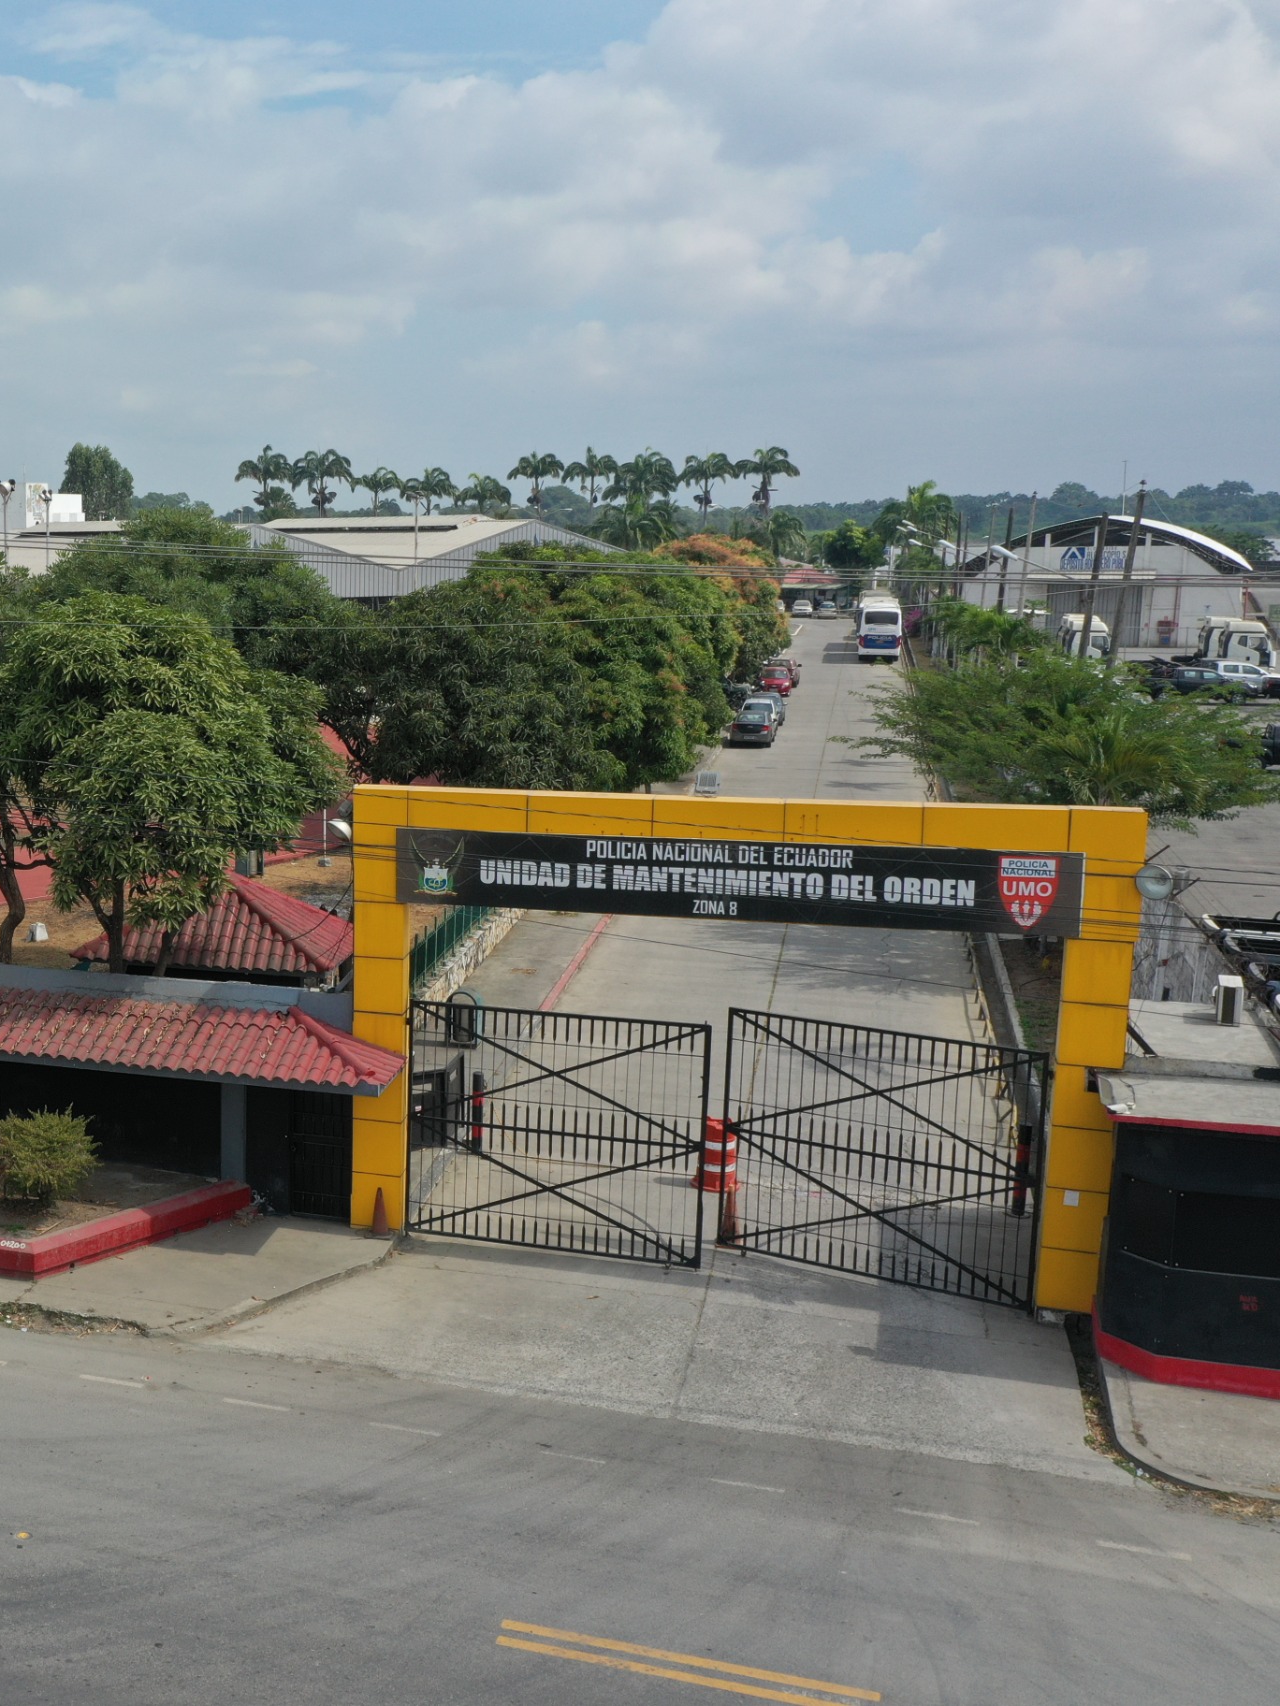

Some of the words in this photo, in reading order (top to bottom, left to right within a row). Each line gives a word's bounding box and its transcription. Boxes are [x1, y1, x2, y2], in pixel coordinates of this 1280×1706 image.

[586, 839, 647, 861] POLICIA
[652, 842, 733, 863] NACIONAL
[738, 845, 768, 865] DEL
[773, 846, 853, 869] ECUADOR
[1002, 867, 1055, 877] NACIONAL
[1008, 860, 1049, 869] POLICIA
[480, 859, 570, 888] UNIDAD
[576, 863, 606, 890] DE
[612, 864, 824, 900] MANTENIMIENTO
[831, 874, 877, 903] DEL
[883, 875, 976, 907] ORDEN
[1002, 880, 1053, 897] UMO
[692, 900, 725, 915] ZONA
[729, 901, 738, 916] 8
